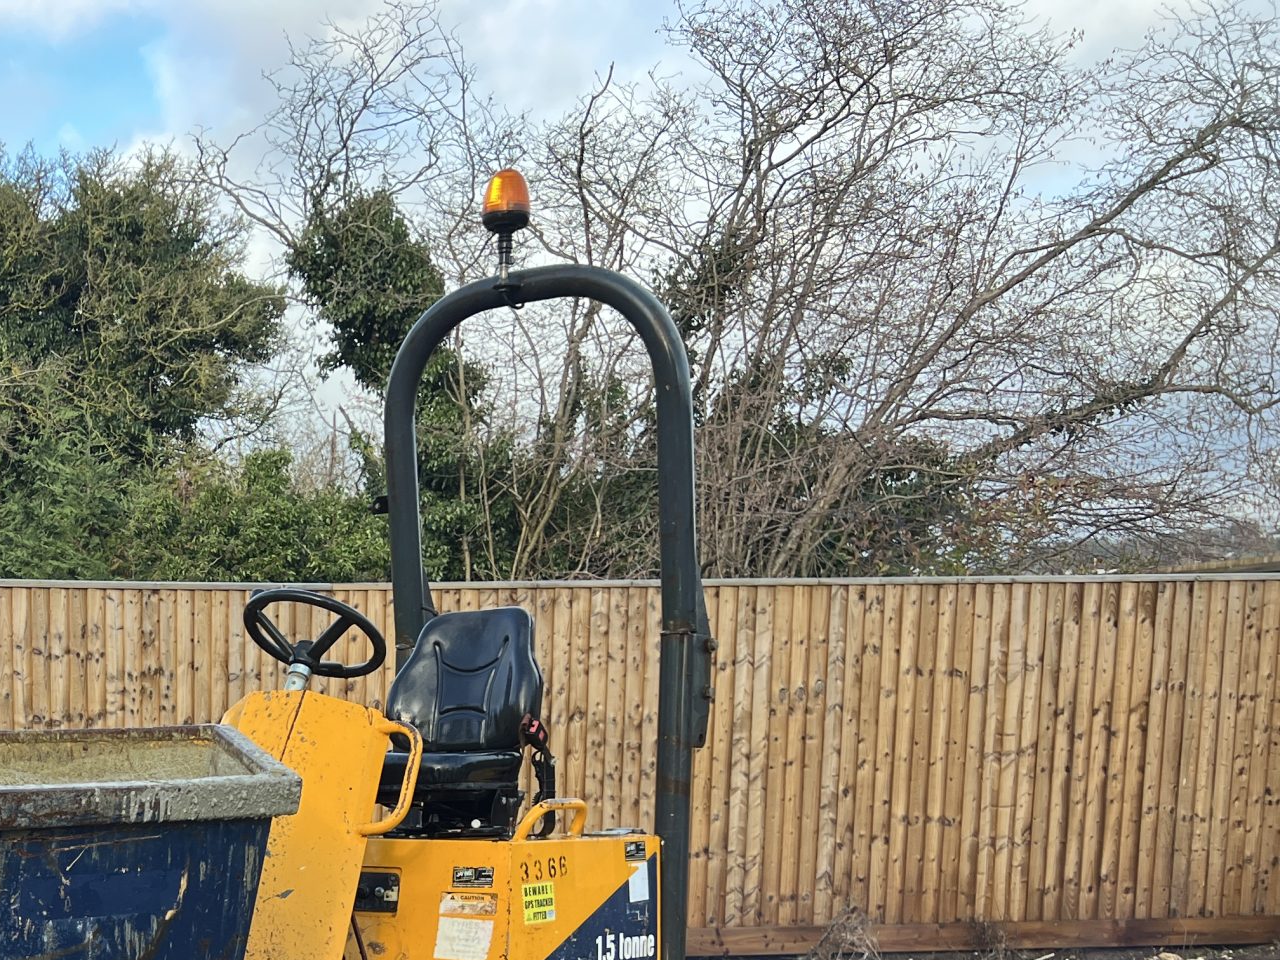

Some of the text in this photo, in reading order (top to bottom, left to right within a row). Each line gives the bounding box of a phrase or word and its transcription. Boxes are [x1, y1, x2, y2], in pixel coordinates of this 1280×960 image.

[524, 885, 548, 897] BEWARE
[525, 898, 553, 909] GPS TRACKER
[533, 911, 547, 920] FITTED
[619, 932, 655, 960] tonne
